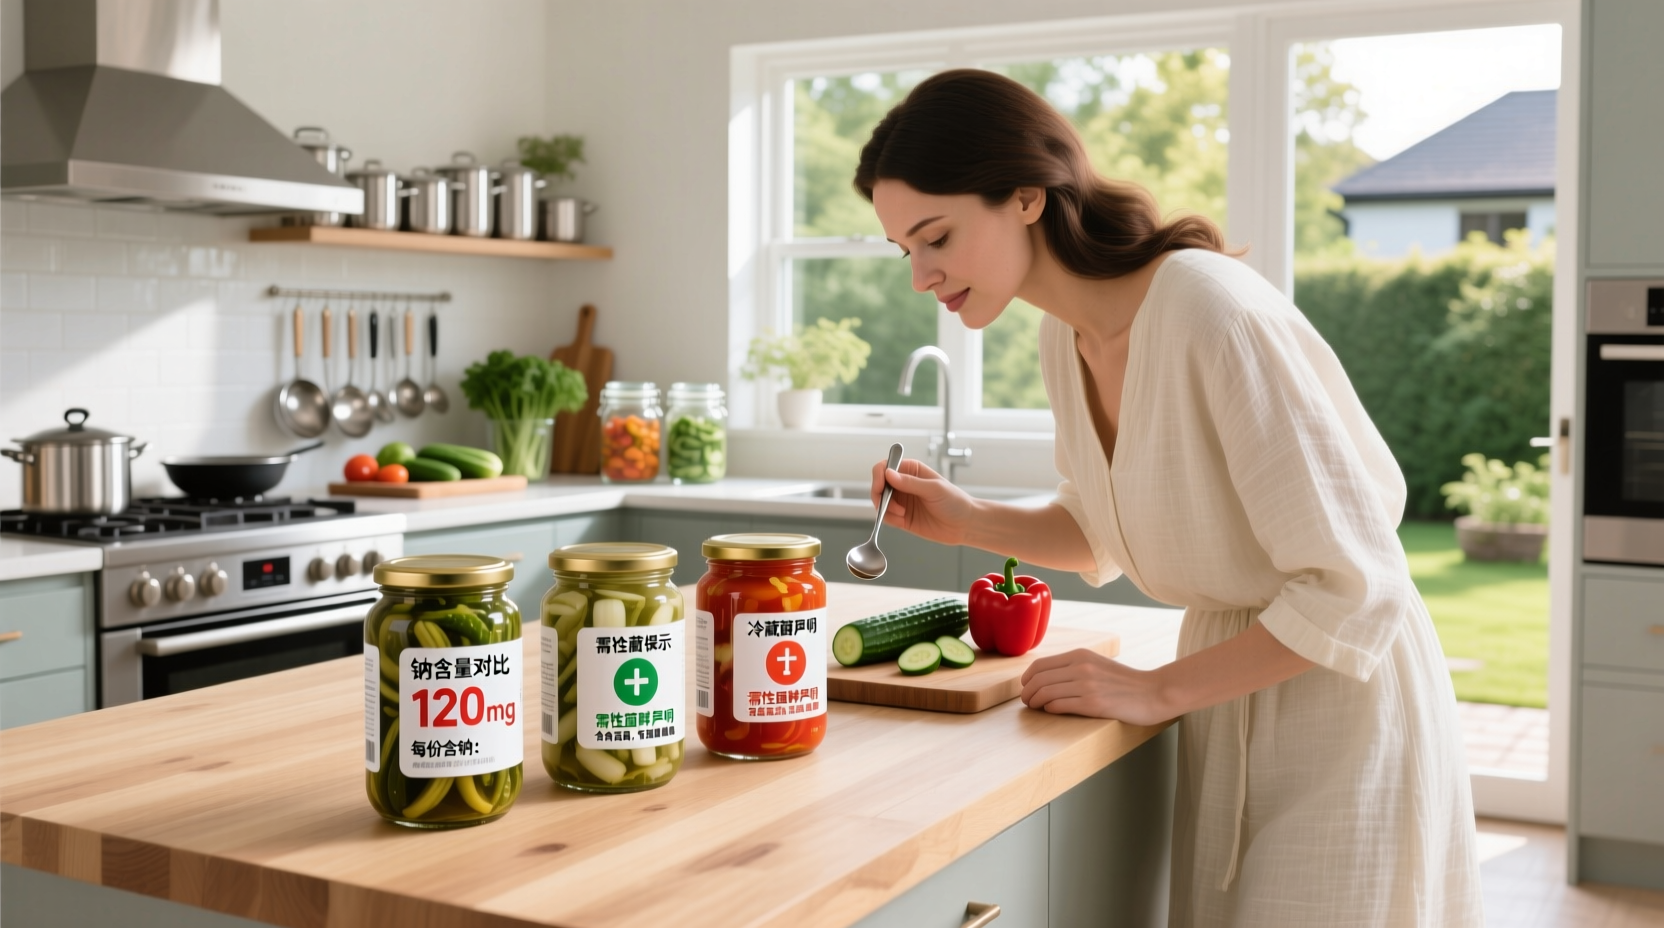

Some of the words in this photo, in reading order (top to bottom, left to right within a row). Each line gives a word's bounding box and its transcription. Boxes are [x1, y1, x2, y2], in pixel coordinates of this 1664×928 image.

[411, 653, 510, 681] 钠含量对比
[411, 686, 516, 728] 120mg
